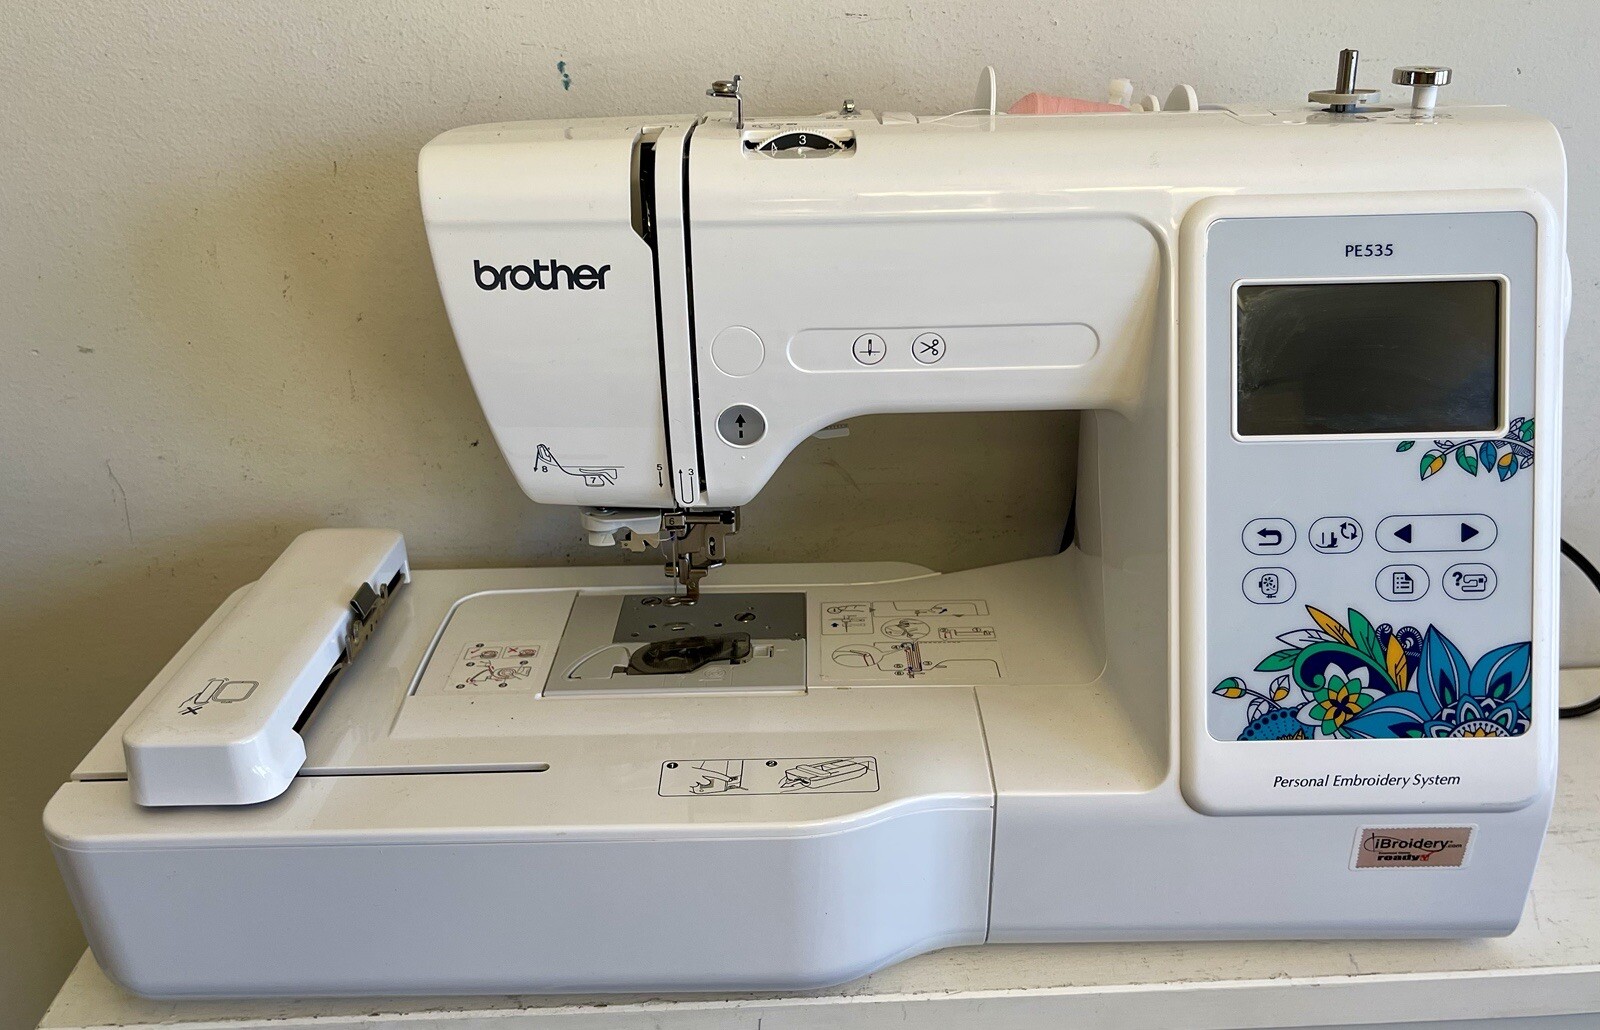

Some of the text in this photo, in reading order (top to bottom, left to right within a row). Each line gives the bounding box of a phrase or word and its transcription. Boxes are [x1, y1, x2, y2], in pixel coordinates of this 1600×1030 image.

[798, 134, 807, 145] 3
[1345, 243, 1394, 257] PE535
[473, 259, 611, 291] brother
[541, 465, 549, 473] 8
[1273, 773, 1461, 789] Personal Embroidery System
